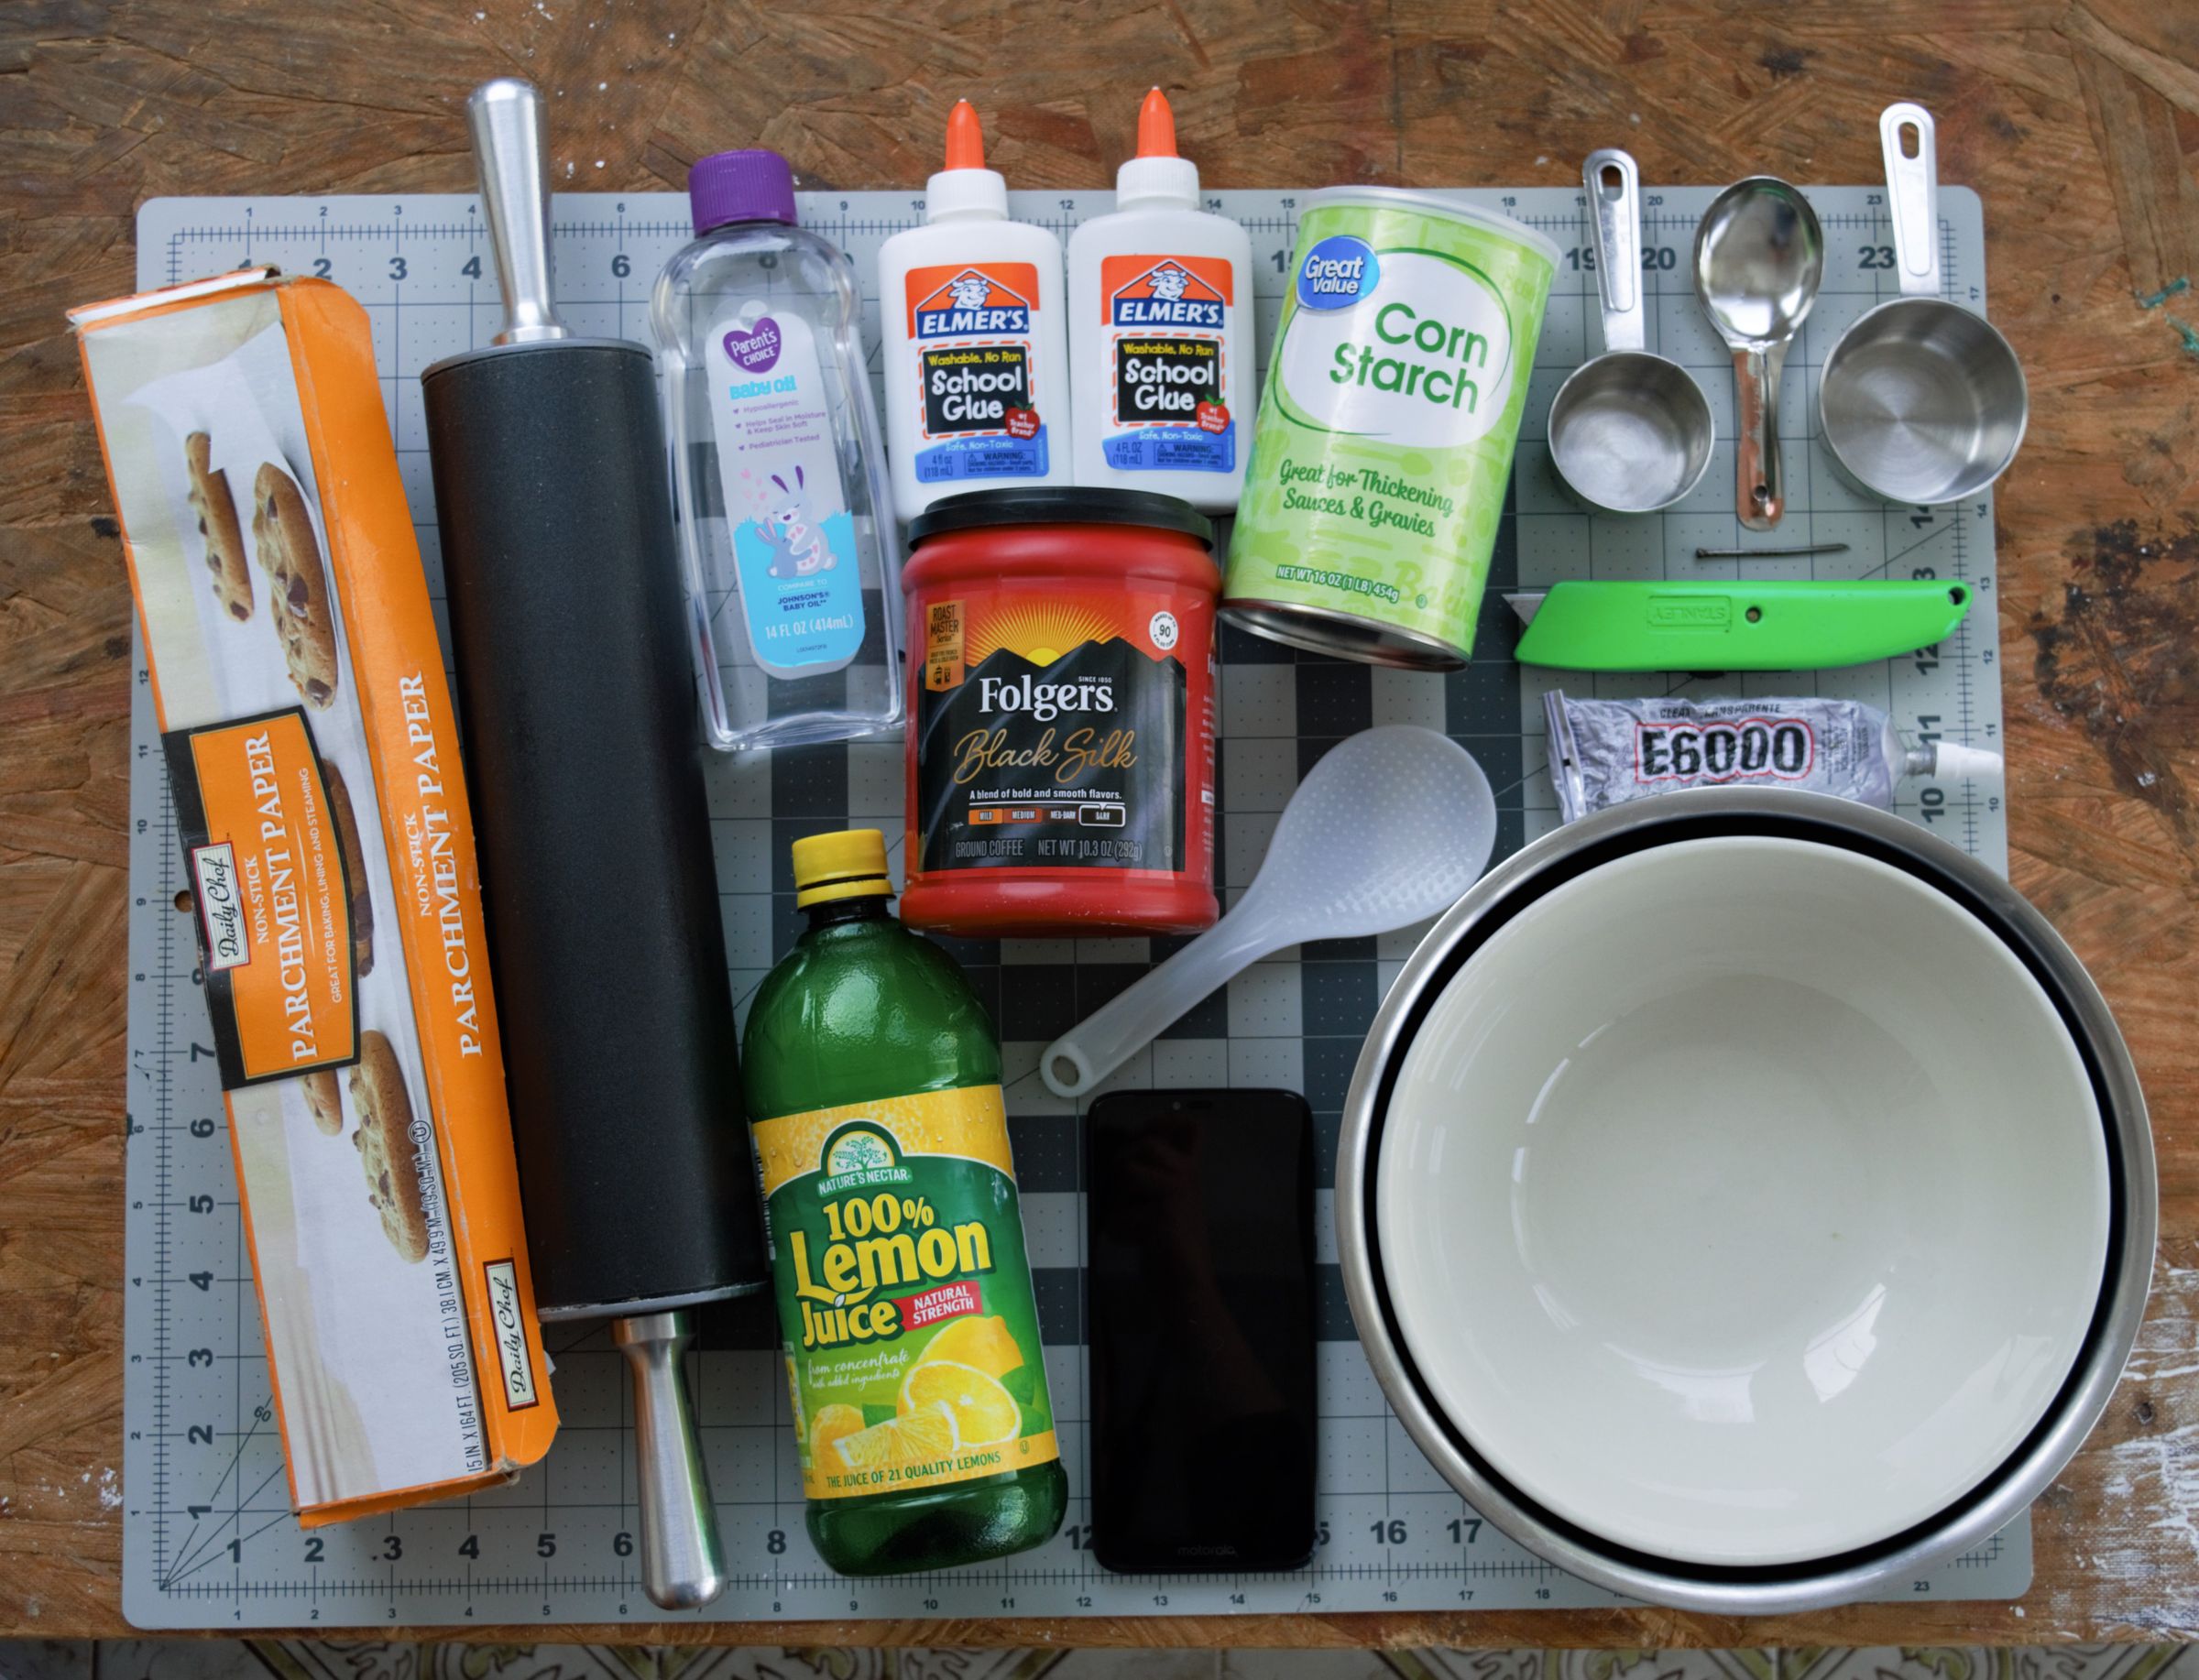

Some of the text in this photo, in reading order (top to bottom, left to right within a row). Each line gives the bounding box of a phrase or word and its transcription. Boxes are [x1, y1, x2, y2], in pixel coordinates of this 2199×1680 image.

[1059, 200, 1074, 210] 12
[1207, 199, 1221, 209] 14
[1502, 196, 1516, 207] 18
[1647, 195, 1663, 206] 20
[388, 256, 408, 279] 3
[610, 254, 631, 278] 6
[1304, 254, 1363, 278] Great
[1857, 245, 1895, 269] 23
[1312, 277, 1358, 294] Value
[922, 310, 1023, 334] ELMER'S
[1119, 302, 1220, 323] ELMER'S
[730, 327, 777, 357] Parent's
[1375, 302, 1488, 367] Corn
[743, 348, 776, 365] CHOICE
[984, 351, 1000, 363] No
[1001, 350, 1022, 363] Run
[1178, 344, 1193, 355] No
[1195, 344, 1213, 355] Run
[931, 365, 1022, 395] School
[1124, 357, 1213, 385] School
[1329, 343, 1478, 413] Starch
[942, 394, 1004, 420] Glue
[1134, 385, 1196, 409] Glue
[1279, 459, 1453, 518] Great for Thickening
[1283, 487, 1435, 537] Sauces & Gravies
[1276, 565, 1399, 601] NET WT 16 OZ (1 LB) 454g
[1980, 575, 1990, 591] 13
[783, 602, 805, 611] BABY
[933, 604, 955, 621] ROAST
[764, 614, 853, 639] 14 FL OZ (414mL)
[930, 618, 958, 636] MASTER
[1158, 624, 1171, 638] 90
[1983, 649, 1993, 664] 12
[979, 674, 1114, 721] Folgers
[953, 727, 1137, 783] Black Silk
[1640, 725, 1805, 777] E6000
[299, 767, 317, 825] STEAMING
[969, 788, 1122, 800] A blend of bold and smooth flavors.
[1920, 786, 1944, 824] 10
[137, 818, 147, 835] 10
[979, 811, 992, 820] MILD
[1012, 810, 1035, 819] MEDIUM
[310, 824, 321, 851] AND
[954, 838, 1023, 857] GROUND COFFEE
[1037, 839, 1143, 861] NET WT 10.3 OZ (292g)
[313, 853, 328, 892] LINING
[399, 671, 482, 1058] PARCHMENT PAPER
[405, 813, 432, 917] NON-STICK
[202, 856, 238, 957] Daily Chef
[244, 855, 269, 945] NON-STICK
[245, 730, 317, 1061] PARCHMENT PAPER
[323, 936, 336, 965] FOR
[326, 965, 342, 1003] GREAT
[190, 1042, 215, 1062] 7
[818, 1168, 908, 1195] NATURE'S NECTAR
[189, 1194, 214, 1214] 5
[823, 1193, 934, 1240] 100%
[428, 1229, 446, 1254] 49.9
[433, 1256, 448, 1266] X
[789, 1221, 990, 1304] Lemon
[189, 1271, 213, 1291] 4
[435, 1267, 453, 1289] CM.
[440, 1291, 457, 1314] 38.1
[914, 1284, 969, 1310] NATURAL
[801, 1294, 898, 1347] Juice
[913, 1295, 974, 1325] STRENGTH
[443, 1316, 460, 1338] FT.)
[492, 1276, 525, 1392] Daily Chef
[452, 1360, 469, 1388] (205
[807, 1347, 909, 1385] from concentrate
[456, 1390, 473, 1408] FT.
[253, 1405, 271, 1422] 60
[460, 1410, 477, 1432] 164
[188, 1424, 212, 1445] 2
[463, 1430, 477, 1442] X
[465, 1440, 480, 1458] IN.
[467, 1459, 483, 1472] 15
[826, 1450, 1001, 1489] THE JUICE OF 21 QUALITY LEMONS
[765, 1528, 787, 1554] 8
[1369, 1518, 1406, 1544] 16
[1445, 1517, 1482, 1544] 17
[304, 1536, 324, 1562] 2
[458, 1534, 479, 1558] 4
[612, 1531, 633, 1555] 6
[1535, 1588, 1549, 1599] 18
[1913, 1580, 1929, 1591] 23
[922, 1598, 937, 1610] 10
[1152, 1595, 1167, 1606] 13
[1305, 1592, 1320, 1604] 15
